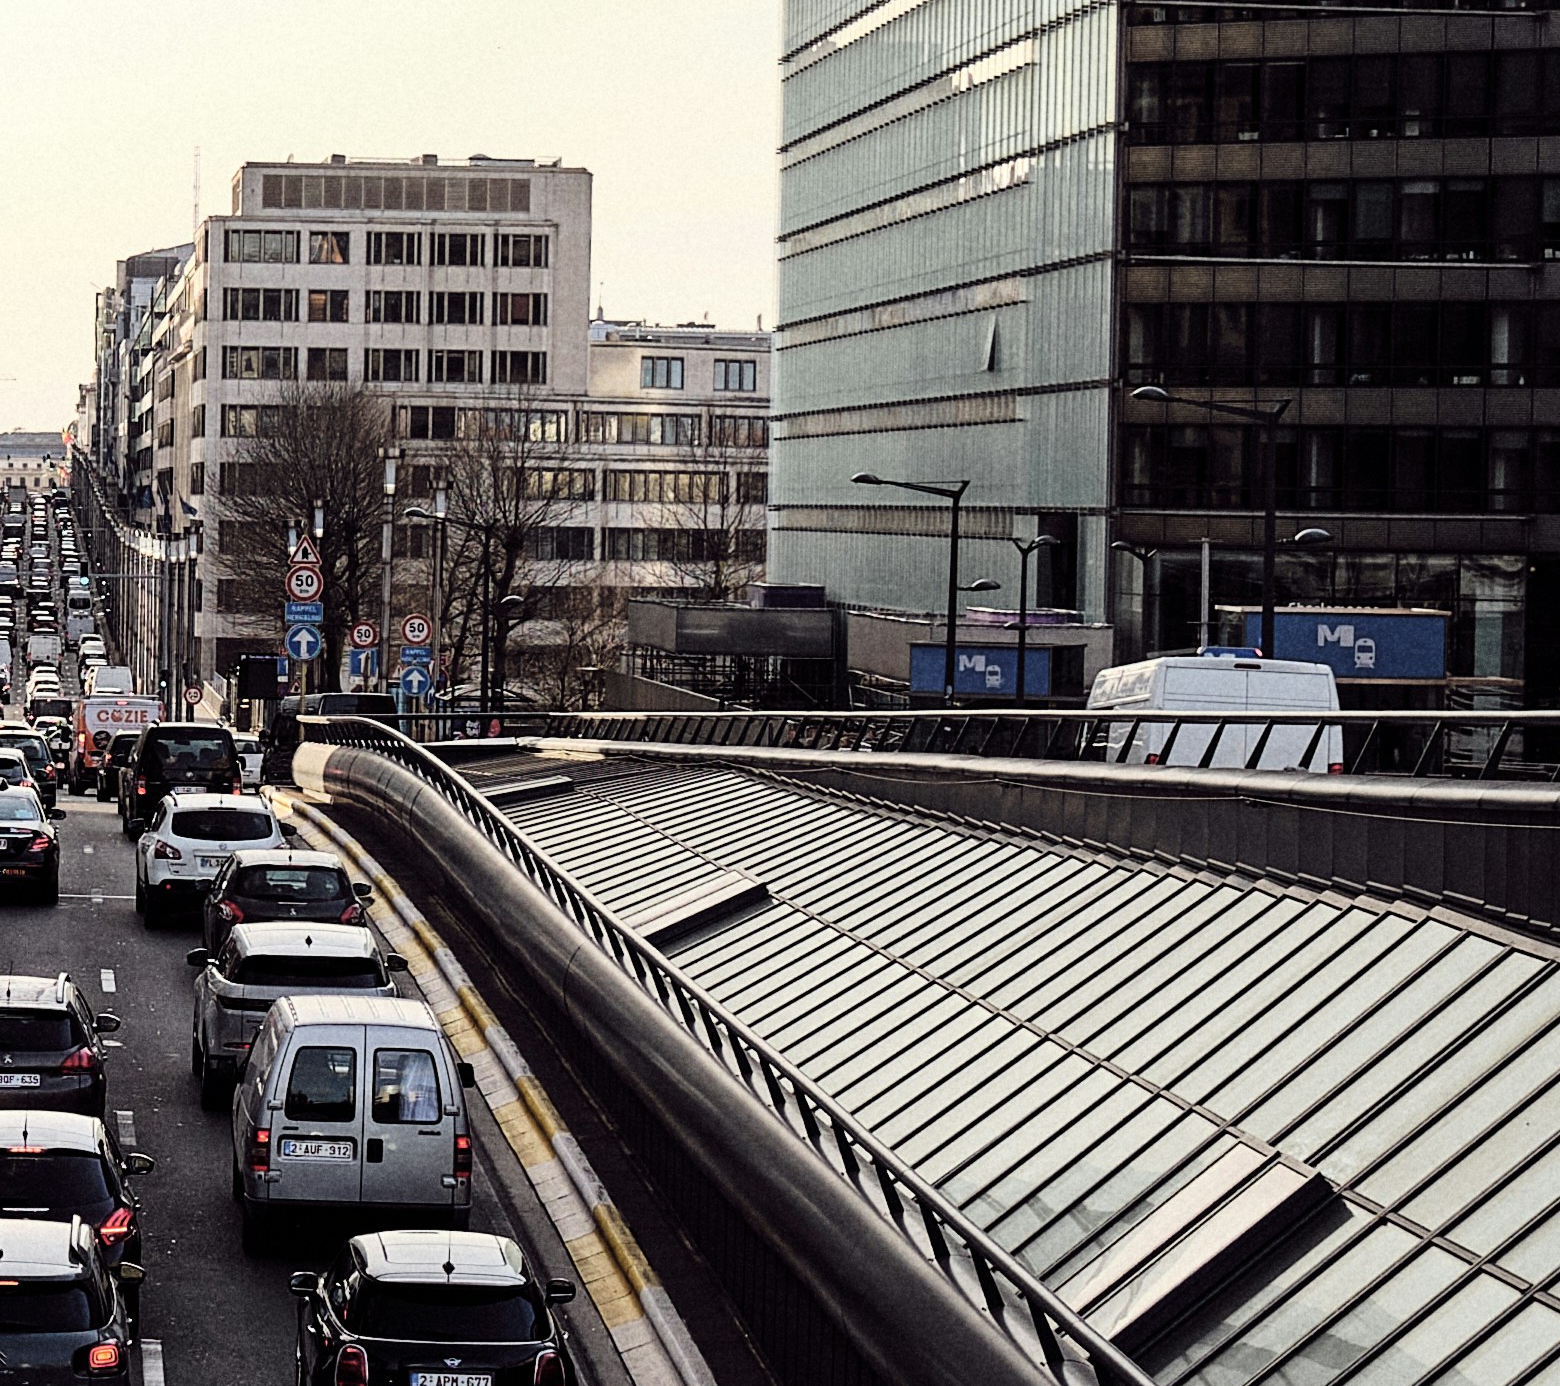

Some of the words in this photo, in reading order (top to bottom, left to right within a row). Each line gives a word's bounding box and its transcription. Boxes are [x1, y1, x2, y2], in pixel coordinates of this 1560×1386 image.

[295, 574, 314, 587] 50
[356, 628, 371, 639] 50
[409, 622, 425, 633] 50
[1317, 625, 1354, 647] M
[959, 655, 986, 672] M
[96, 709, 148, 723] COZIE
